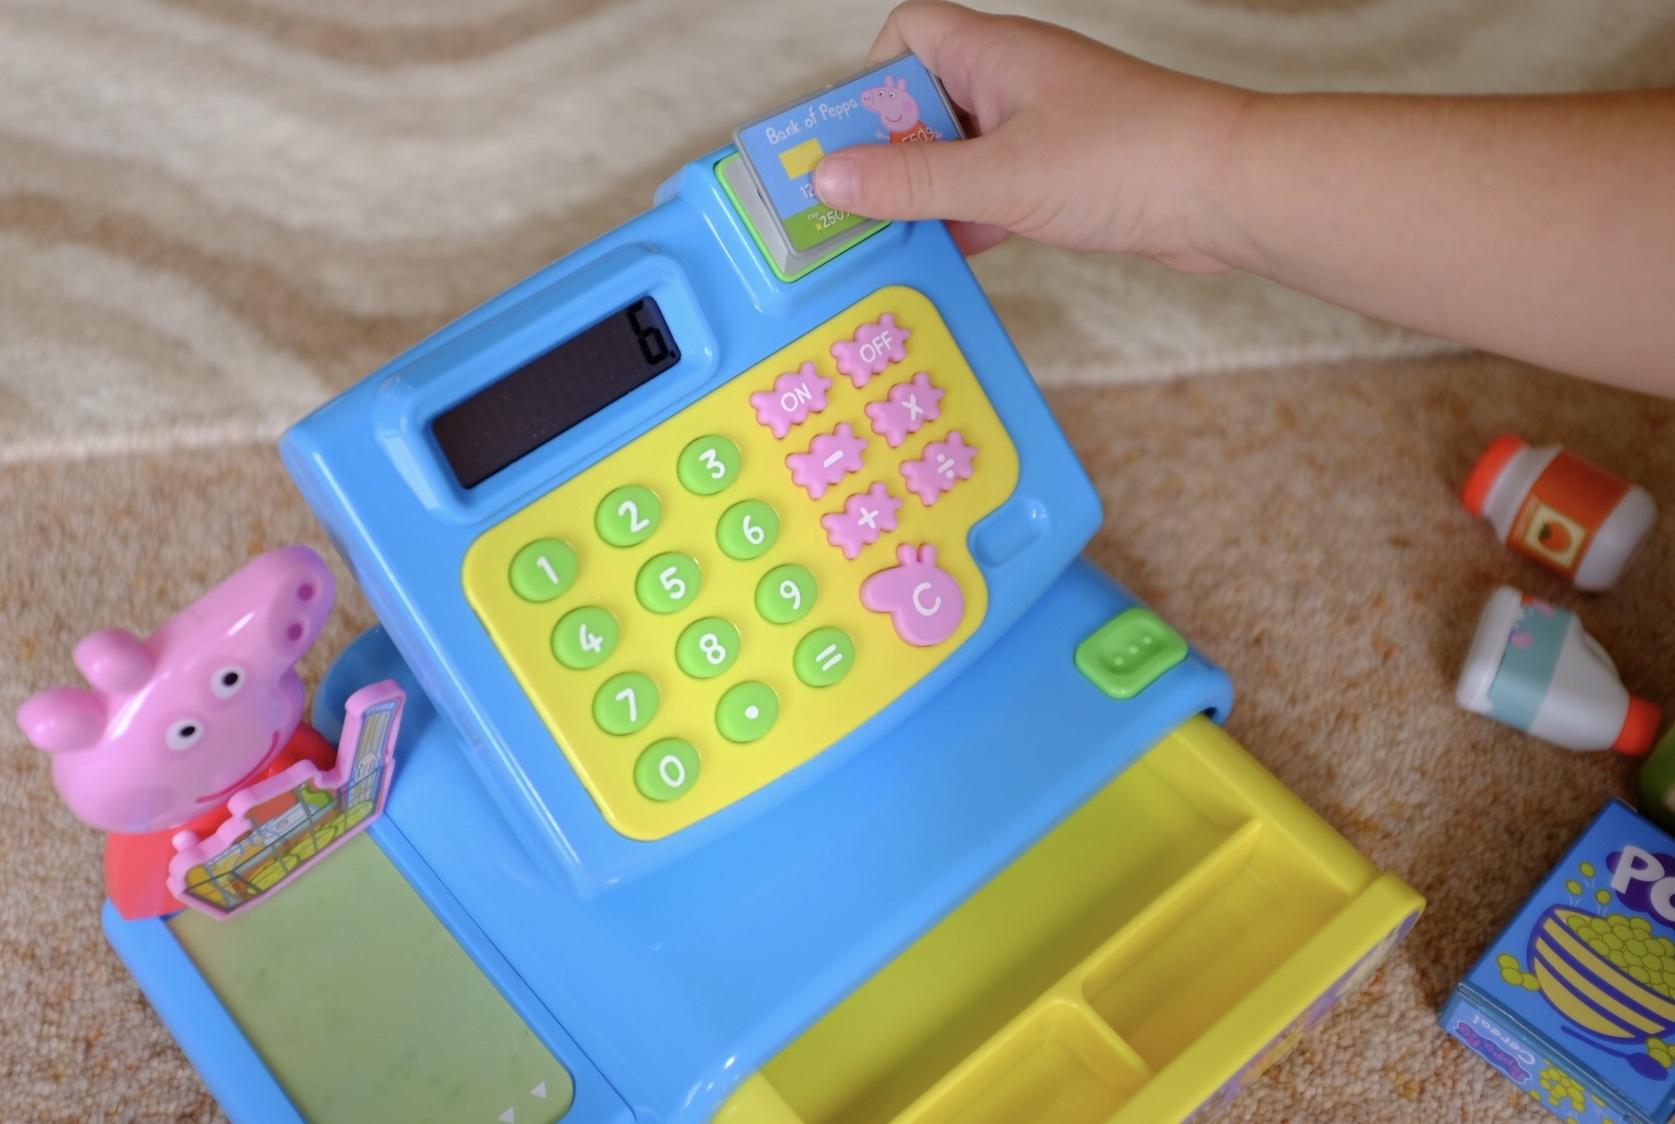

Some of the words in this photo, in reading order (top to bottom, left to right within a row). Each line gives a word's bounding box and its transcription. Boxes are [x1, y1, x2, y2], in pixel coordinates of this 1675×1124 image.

[766, 119, 801, 144] Bank
[804, 106, 817, 128] of
[819, 98, 858, 121] Peppa
[859, 330, 893, 364] OFF
[780, 382, 812, 413] ON
[698, 448, 726, 479] 3
[617, 500, 650, 533] 2
[742, 514, 765, 545] 6
[536, 555, 560, 585] 1
[658, 566, 686, 600] 5
[779, 579, 801, 610] 9
[912, 581, 942, 617] C
[578, 623, 604, 653] 4
[699, 632, 726, 666] 8
[614, 686, 638, 723] 7
[657, 754, 686, 788] 0
